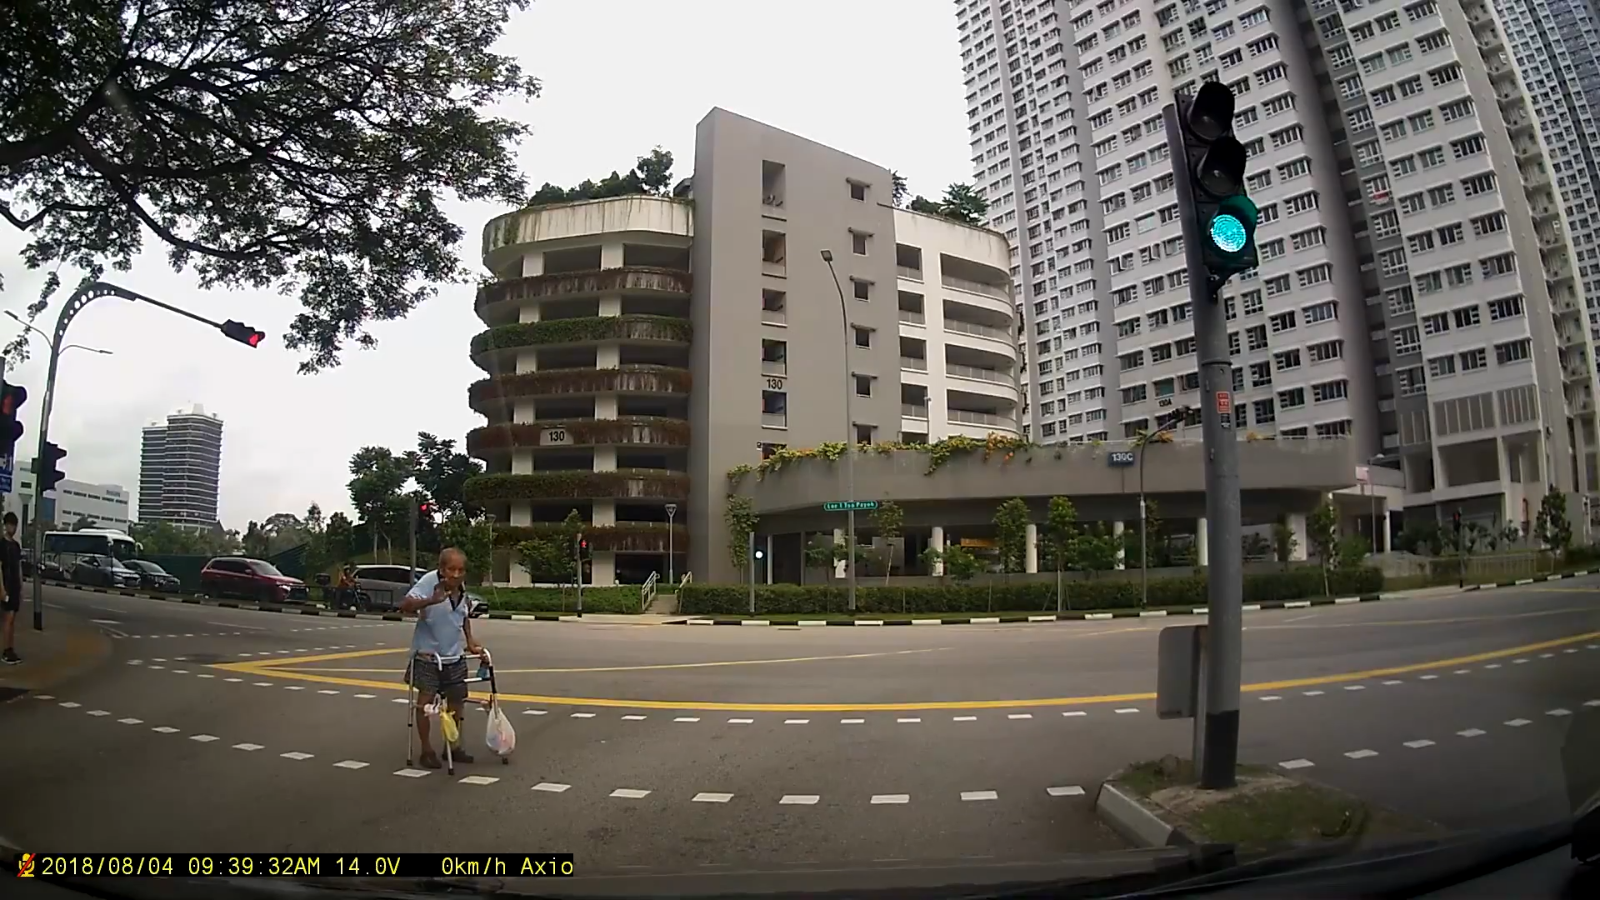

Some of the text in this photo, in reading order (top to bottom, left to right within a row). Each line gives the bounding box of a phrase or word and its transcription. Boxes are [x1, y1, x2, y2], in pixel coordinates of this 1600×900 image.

[766, 378, 783, 390] 130
[549, 431, 564, 441] 130
[1111, 452, 1134, 461] 130C
